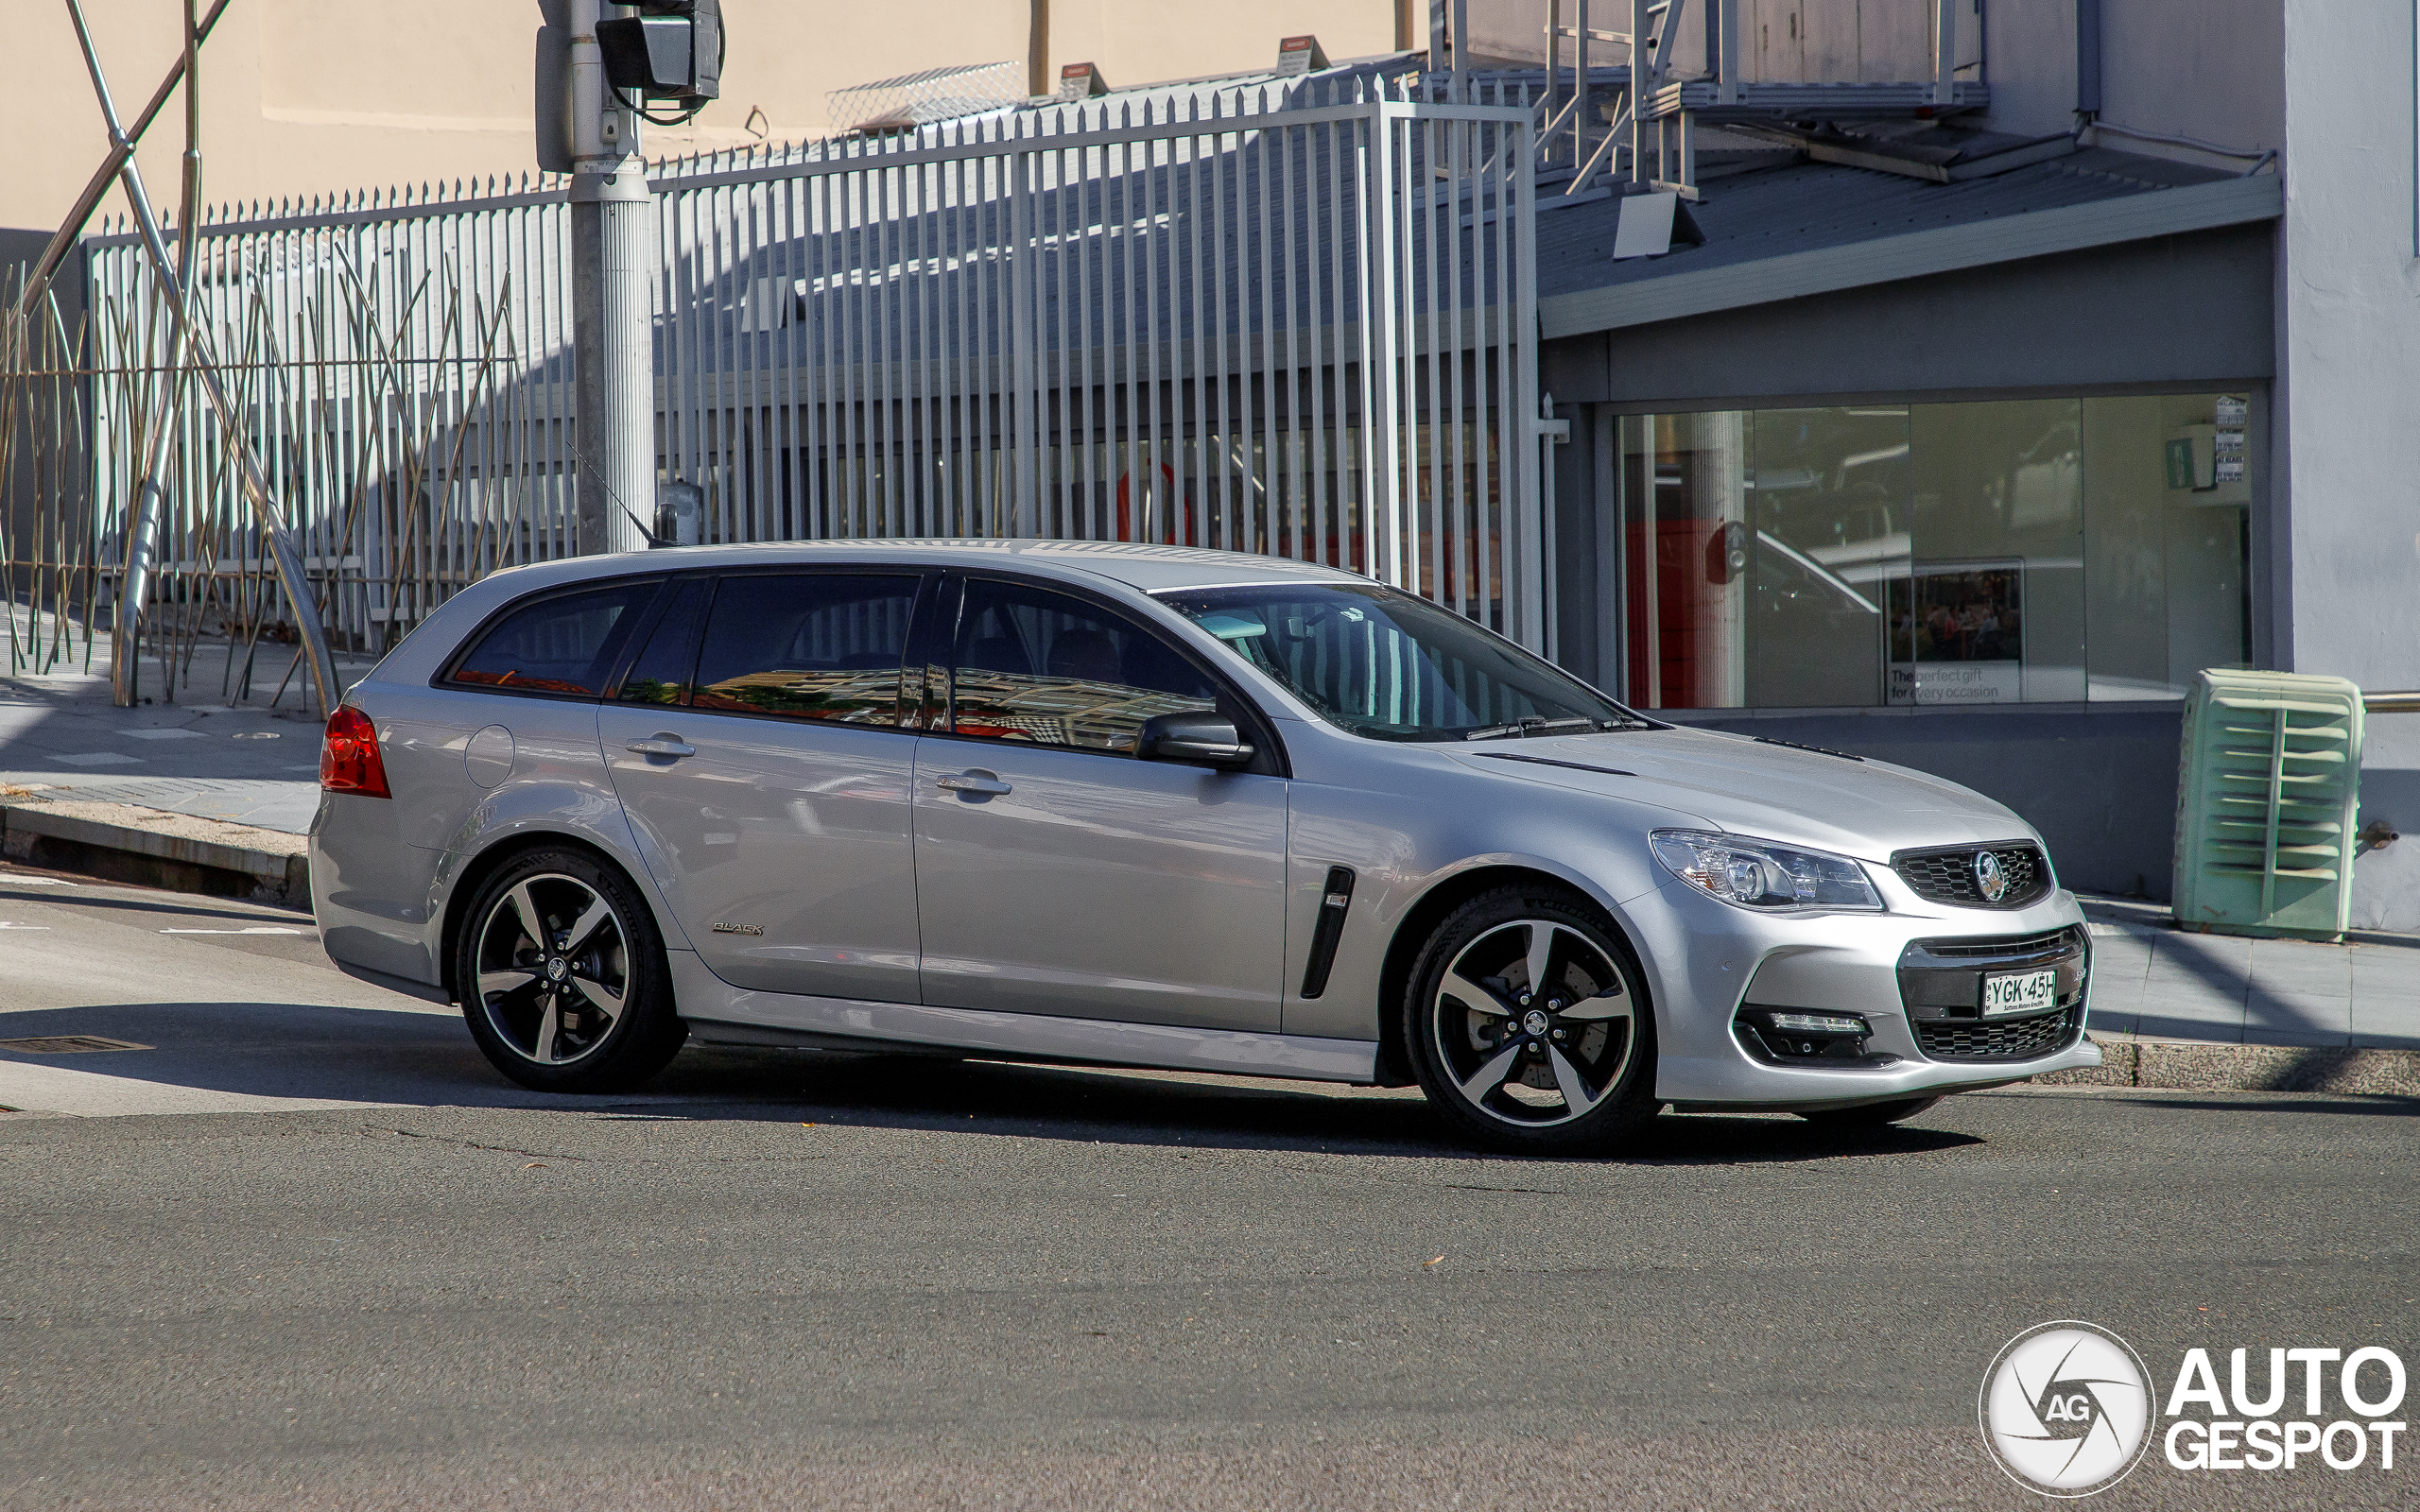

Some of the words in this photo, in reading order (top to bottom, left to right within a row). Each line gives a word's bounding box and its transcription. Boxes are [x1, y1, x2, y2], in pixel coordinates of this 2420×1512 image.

[1892, 669, 1913, 682] The
[1916, 668, 1962, 682] perfect
[1962, 667, 1982, 683] gift
[1892, 686, 1908, 698] for
[1945, 686, 1999, 698] occasion
[713, 922, 765, 936] BLACK
